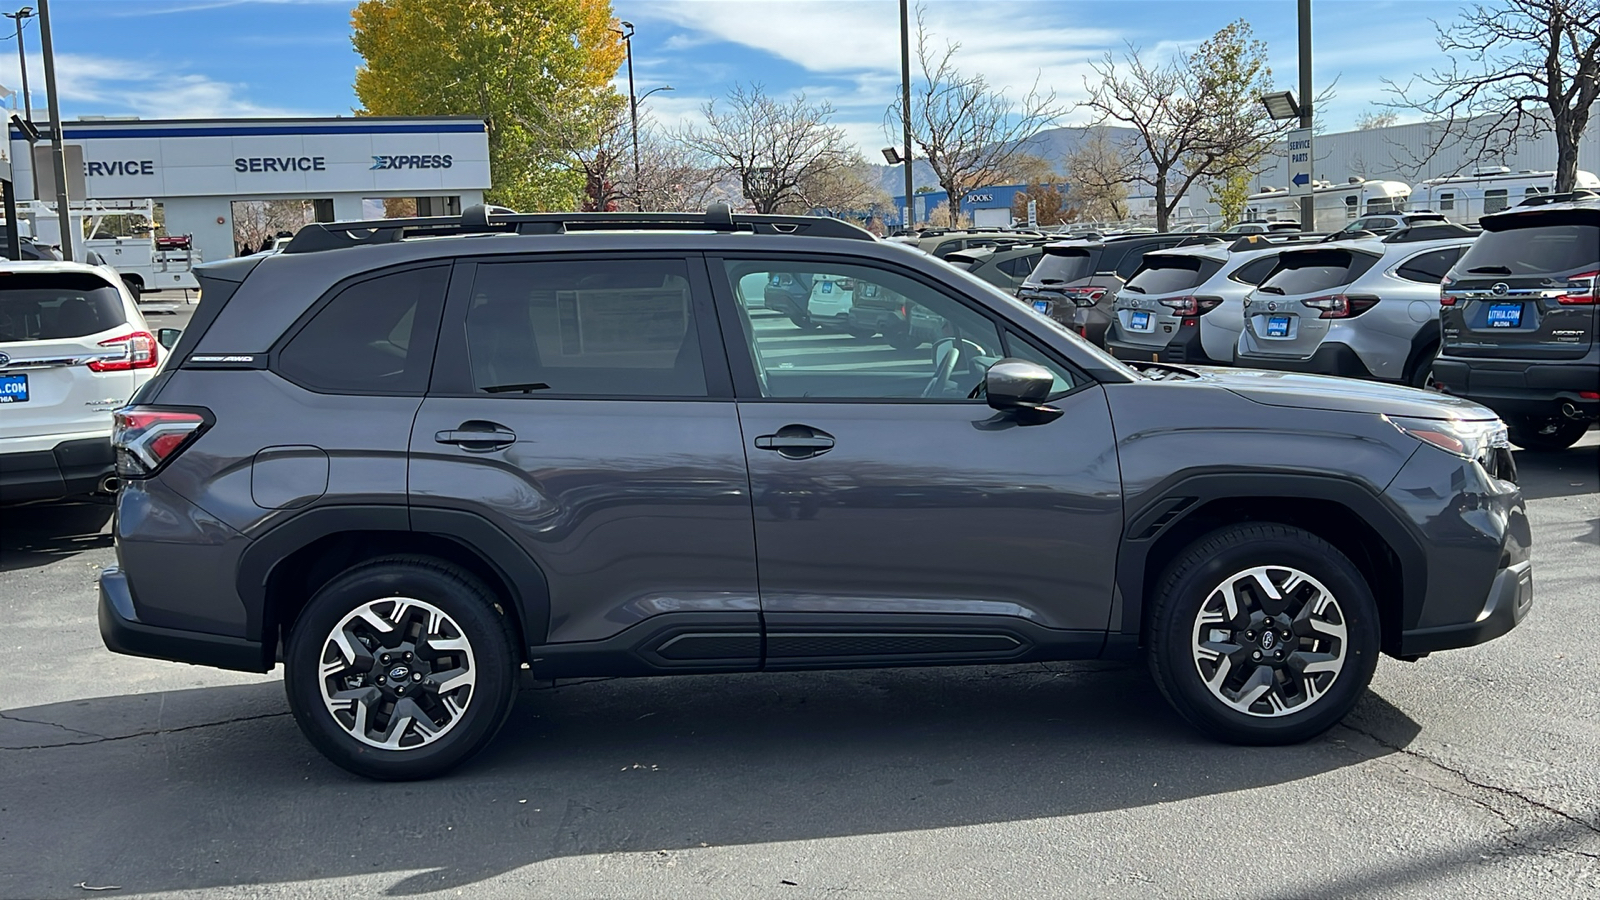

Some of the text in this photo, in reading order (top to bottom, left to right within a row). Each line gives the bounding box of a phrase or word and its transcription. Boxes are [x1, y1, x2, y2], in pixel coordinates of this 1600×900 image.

[1290, 140, 1310, 150] SERVICE
[369, 155, 453, 170] EXPRESS
[1292, 153, 1308, 163] PARTS
[83, 160, 154, 176] RVICE
[234, 157, 326, 172] SERVICE
[967, 194, 993, 203] BOOKS
[1488, 310, 1520, 320] LITHIA.COM
[0, 383, 26, 394] .COM
